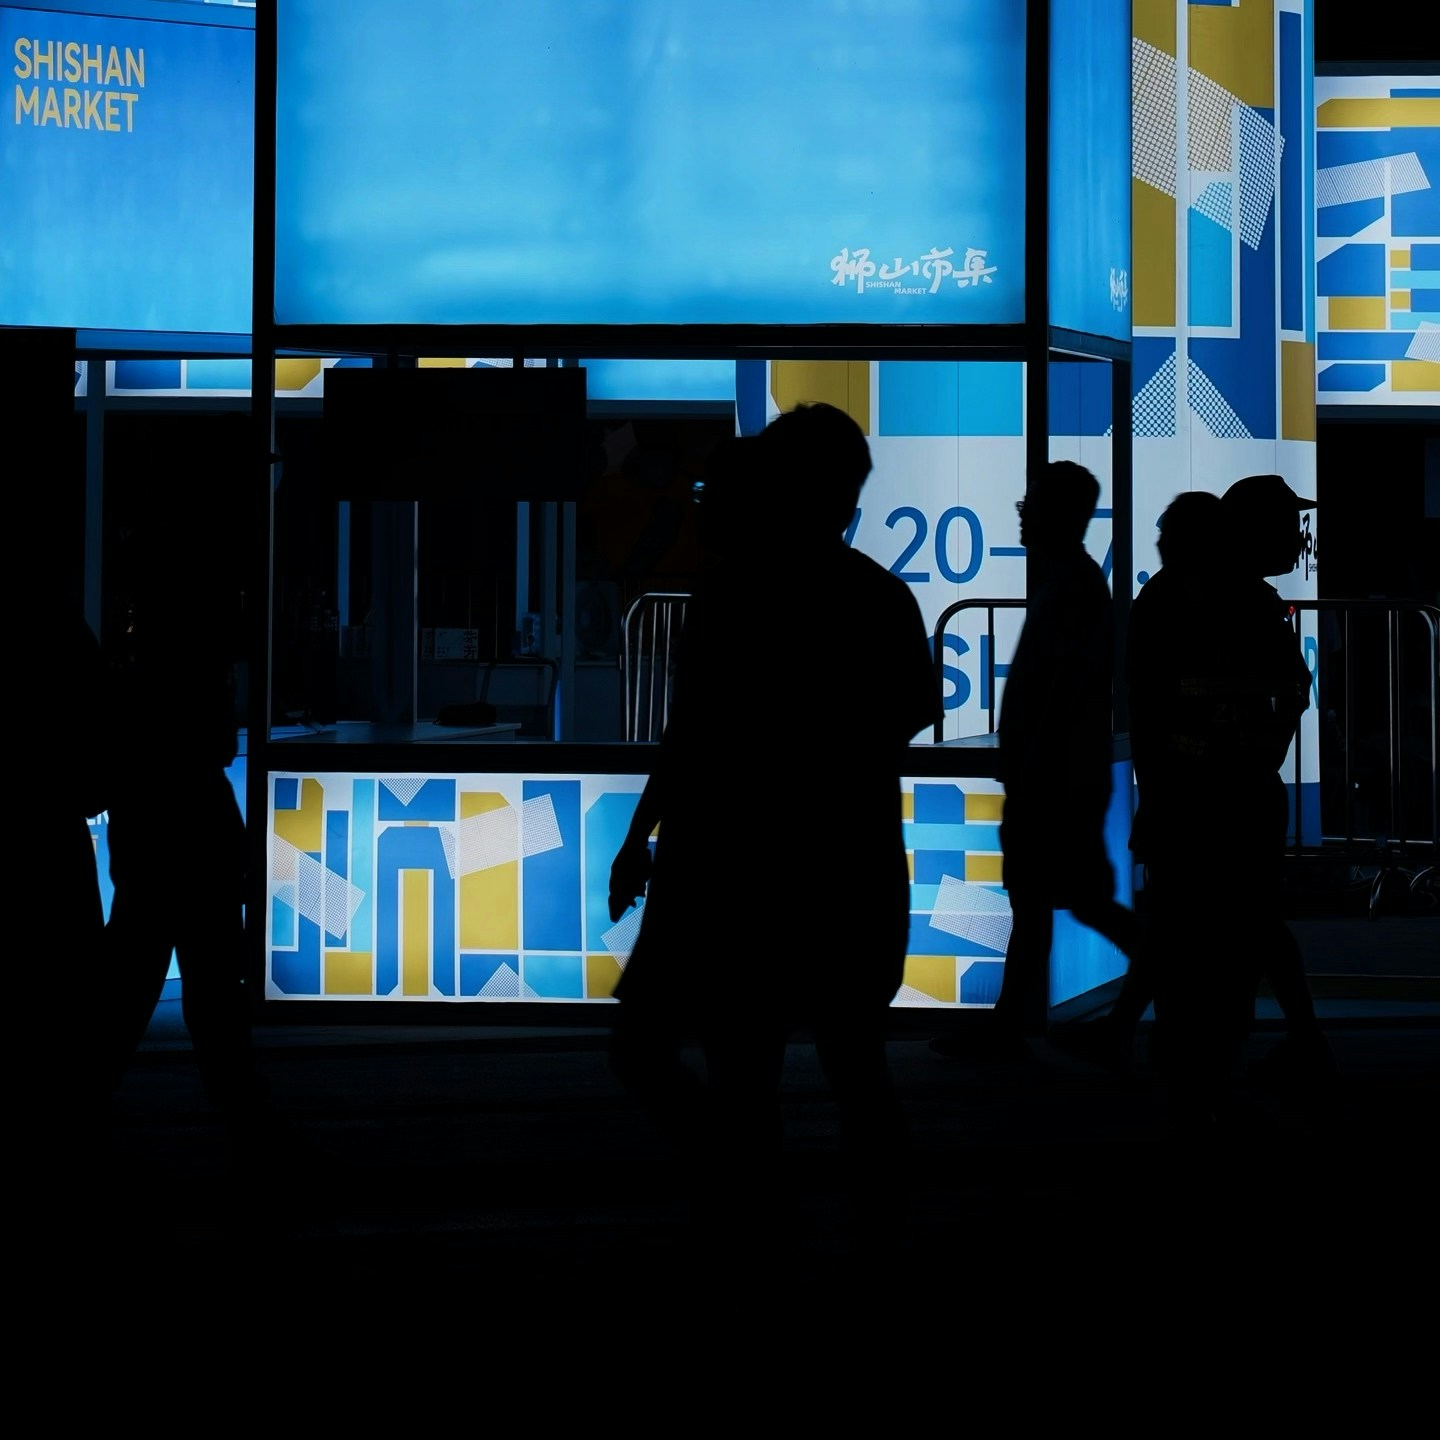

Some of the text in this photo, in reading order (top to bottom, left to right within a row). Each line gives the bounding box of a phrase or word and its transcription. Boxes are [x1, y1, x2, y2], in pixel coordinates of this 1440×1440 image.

[13, 37, 146, 88] SHISHAN
[15, 84, 139, 133] MARKET
[830, 246, 998, 294] 狮山市集
[865, 280, 902, 288] SHISHAN
[894, 287, 928, 295] MARKET
